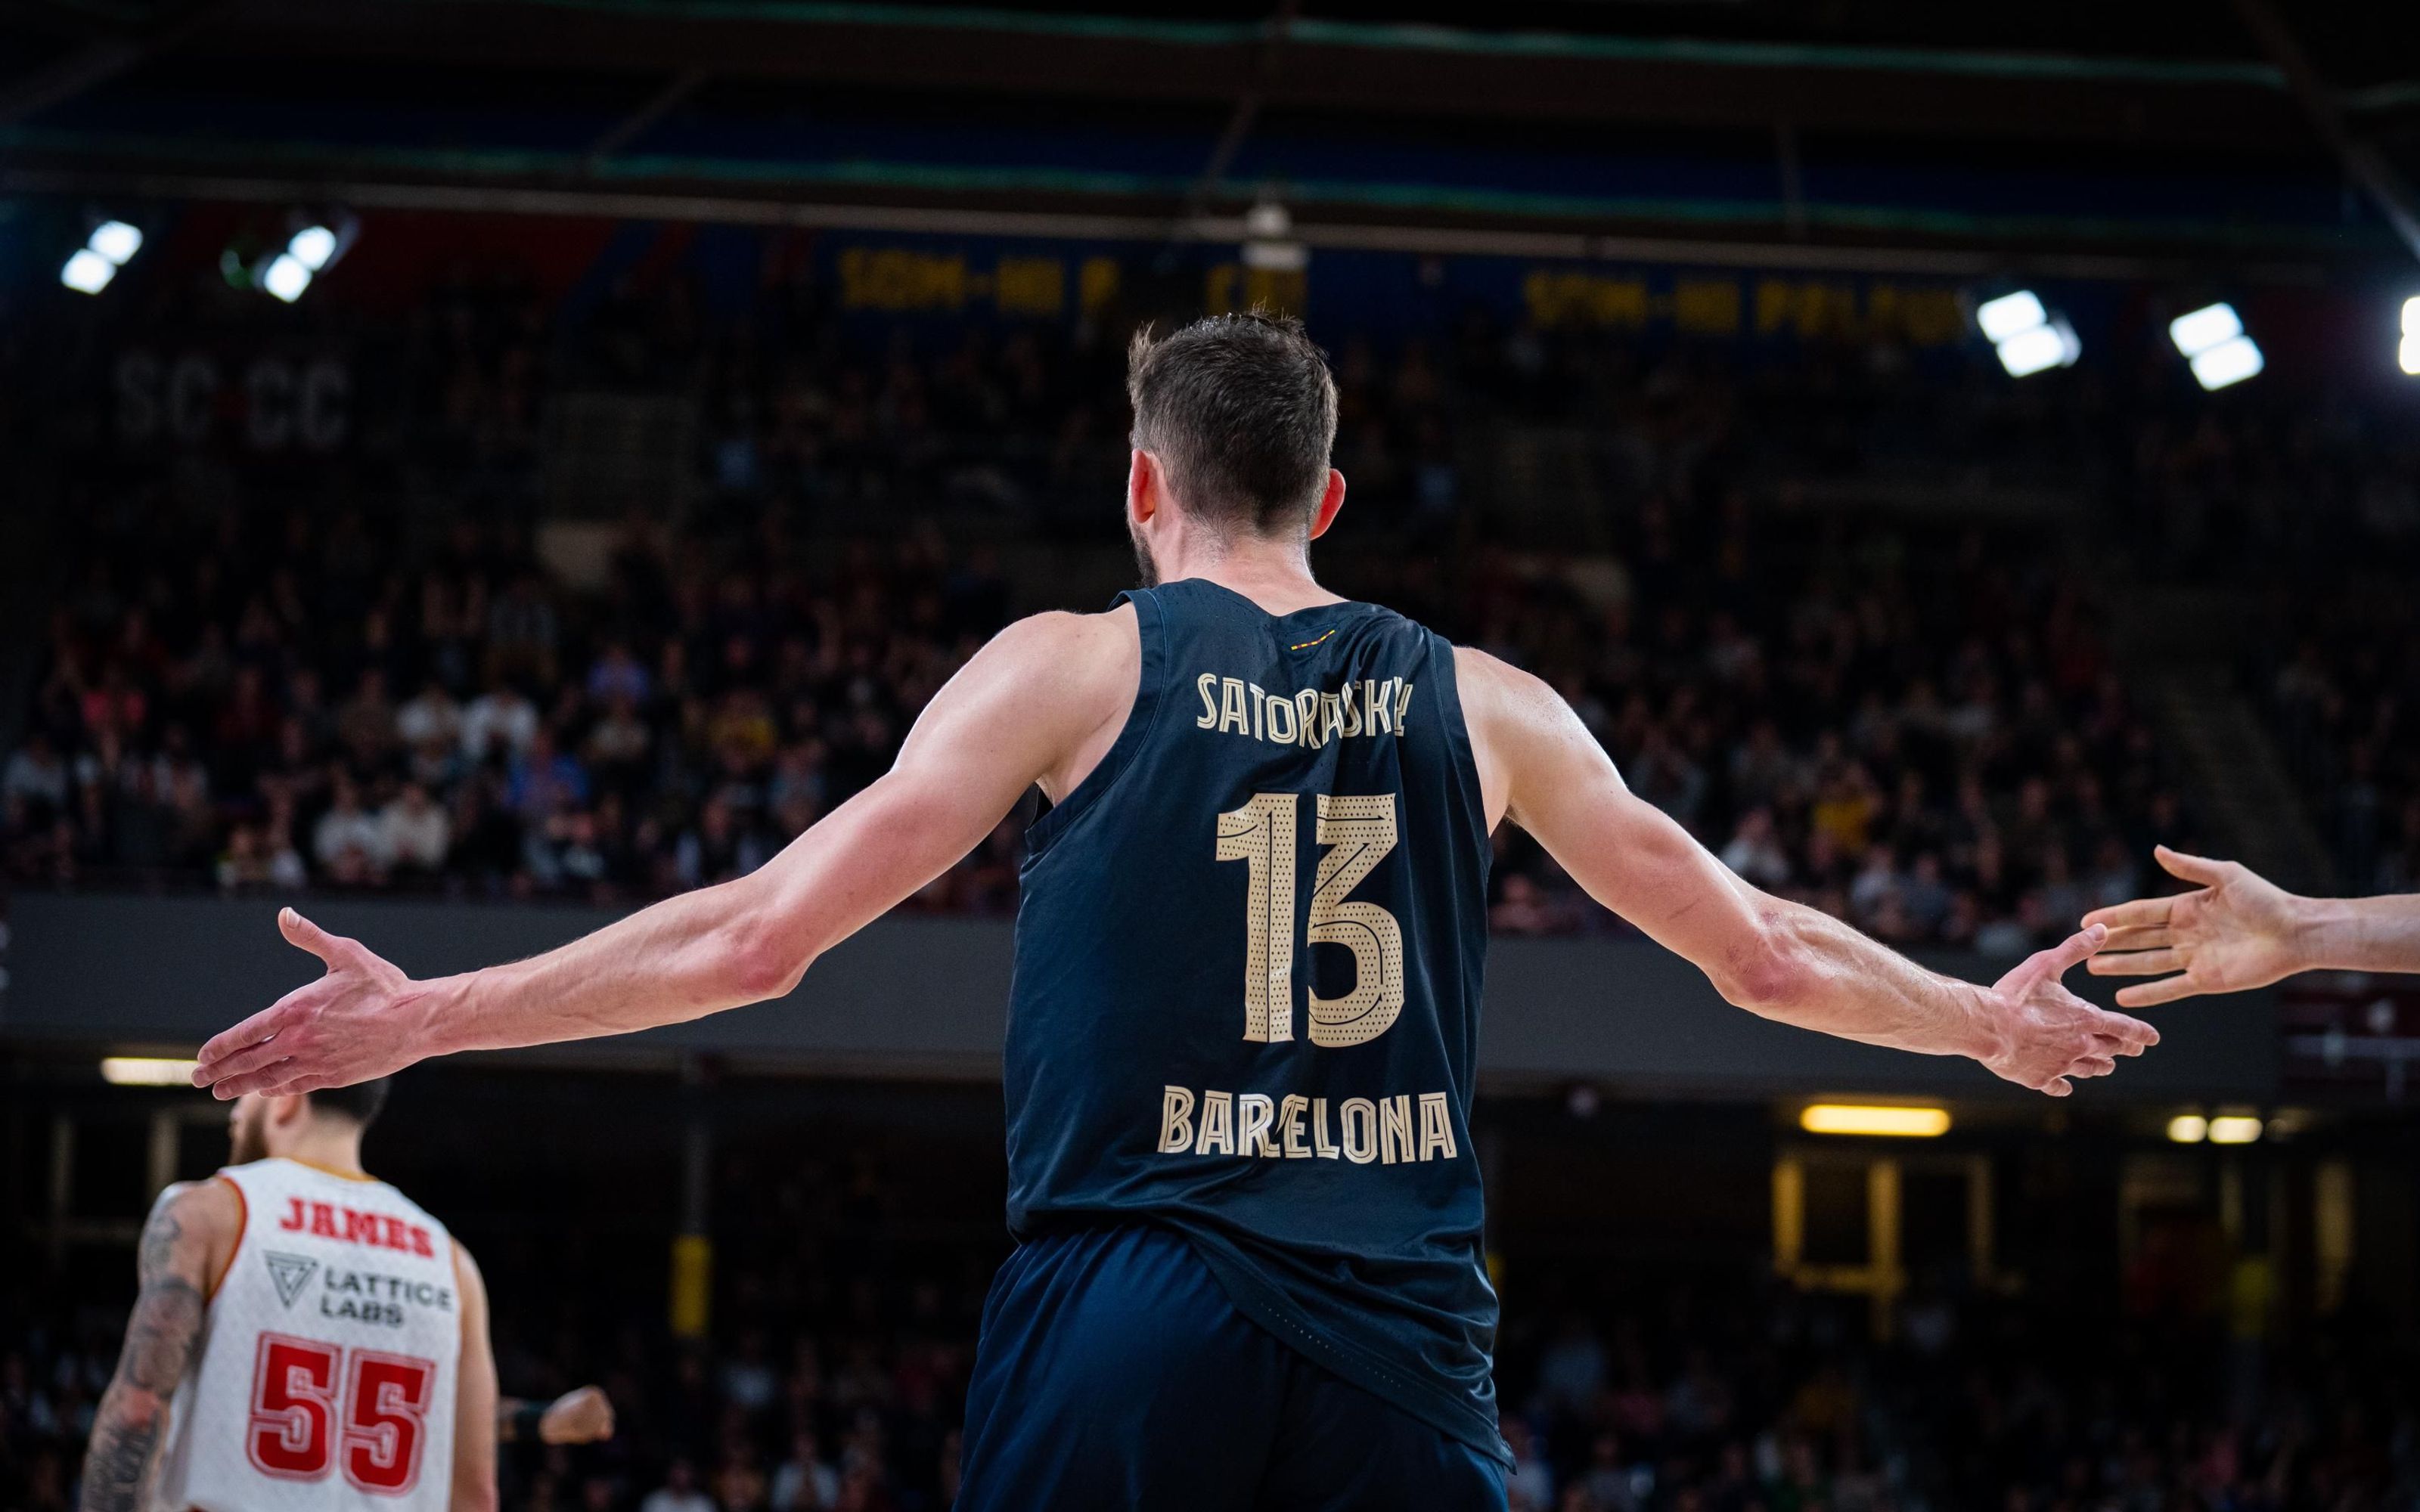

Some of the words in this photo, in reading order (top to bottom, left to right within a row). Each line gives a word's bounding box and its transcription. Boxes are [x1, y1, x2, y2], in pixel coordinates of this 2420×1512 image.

[1215, 792, 1405, 1048] 13
[279, 1195, 435, 1259] JAMES
[320, 1295, 405, 1329] LABS
[324, 1267, 452, 1312] LATTICE
[245, 1329, 437, 1498] 55
